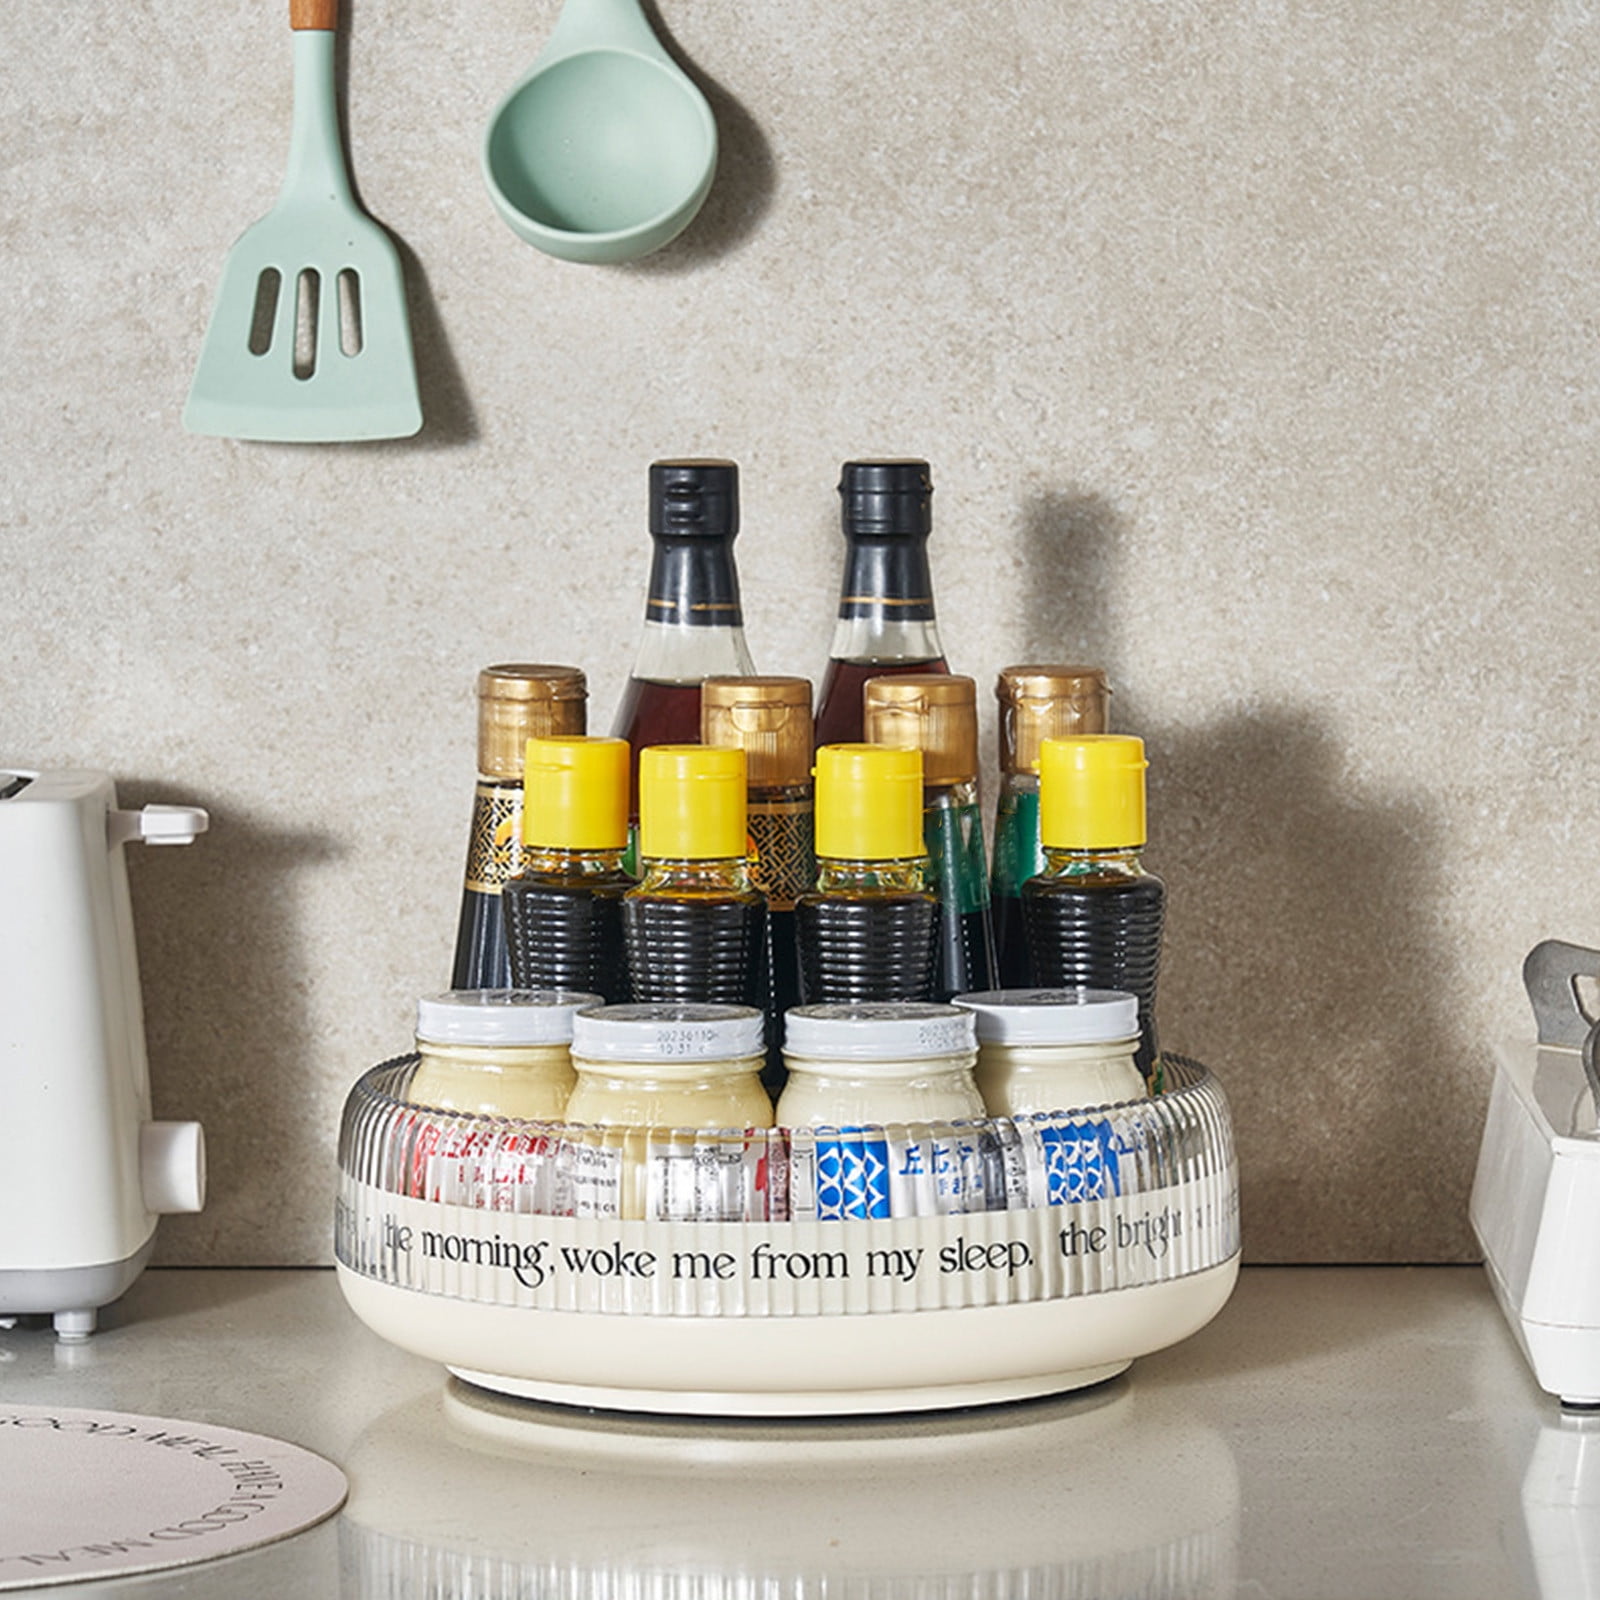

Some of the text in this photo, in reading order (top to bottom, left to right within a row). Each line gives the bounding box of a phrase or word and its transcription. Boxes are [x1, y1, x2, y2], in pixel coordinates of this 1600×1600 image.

[422, 1231, 556, 1289] morning,
[560, 1240, 657, 1279] woke
[672, 1252, 736, 1280] me
[750, 1242, 850, 1280] from
[866, 1249, 925, 1283] my
[939, 1236, 1034, 1278] sleep.
[1058, 1221, 1108, 1258] the
[0, 1415, 138, 1437] OOD
[149, 1501, 266, 1541] GOOD
